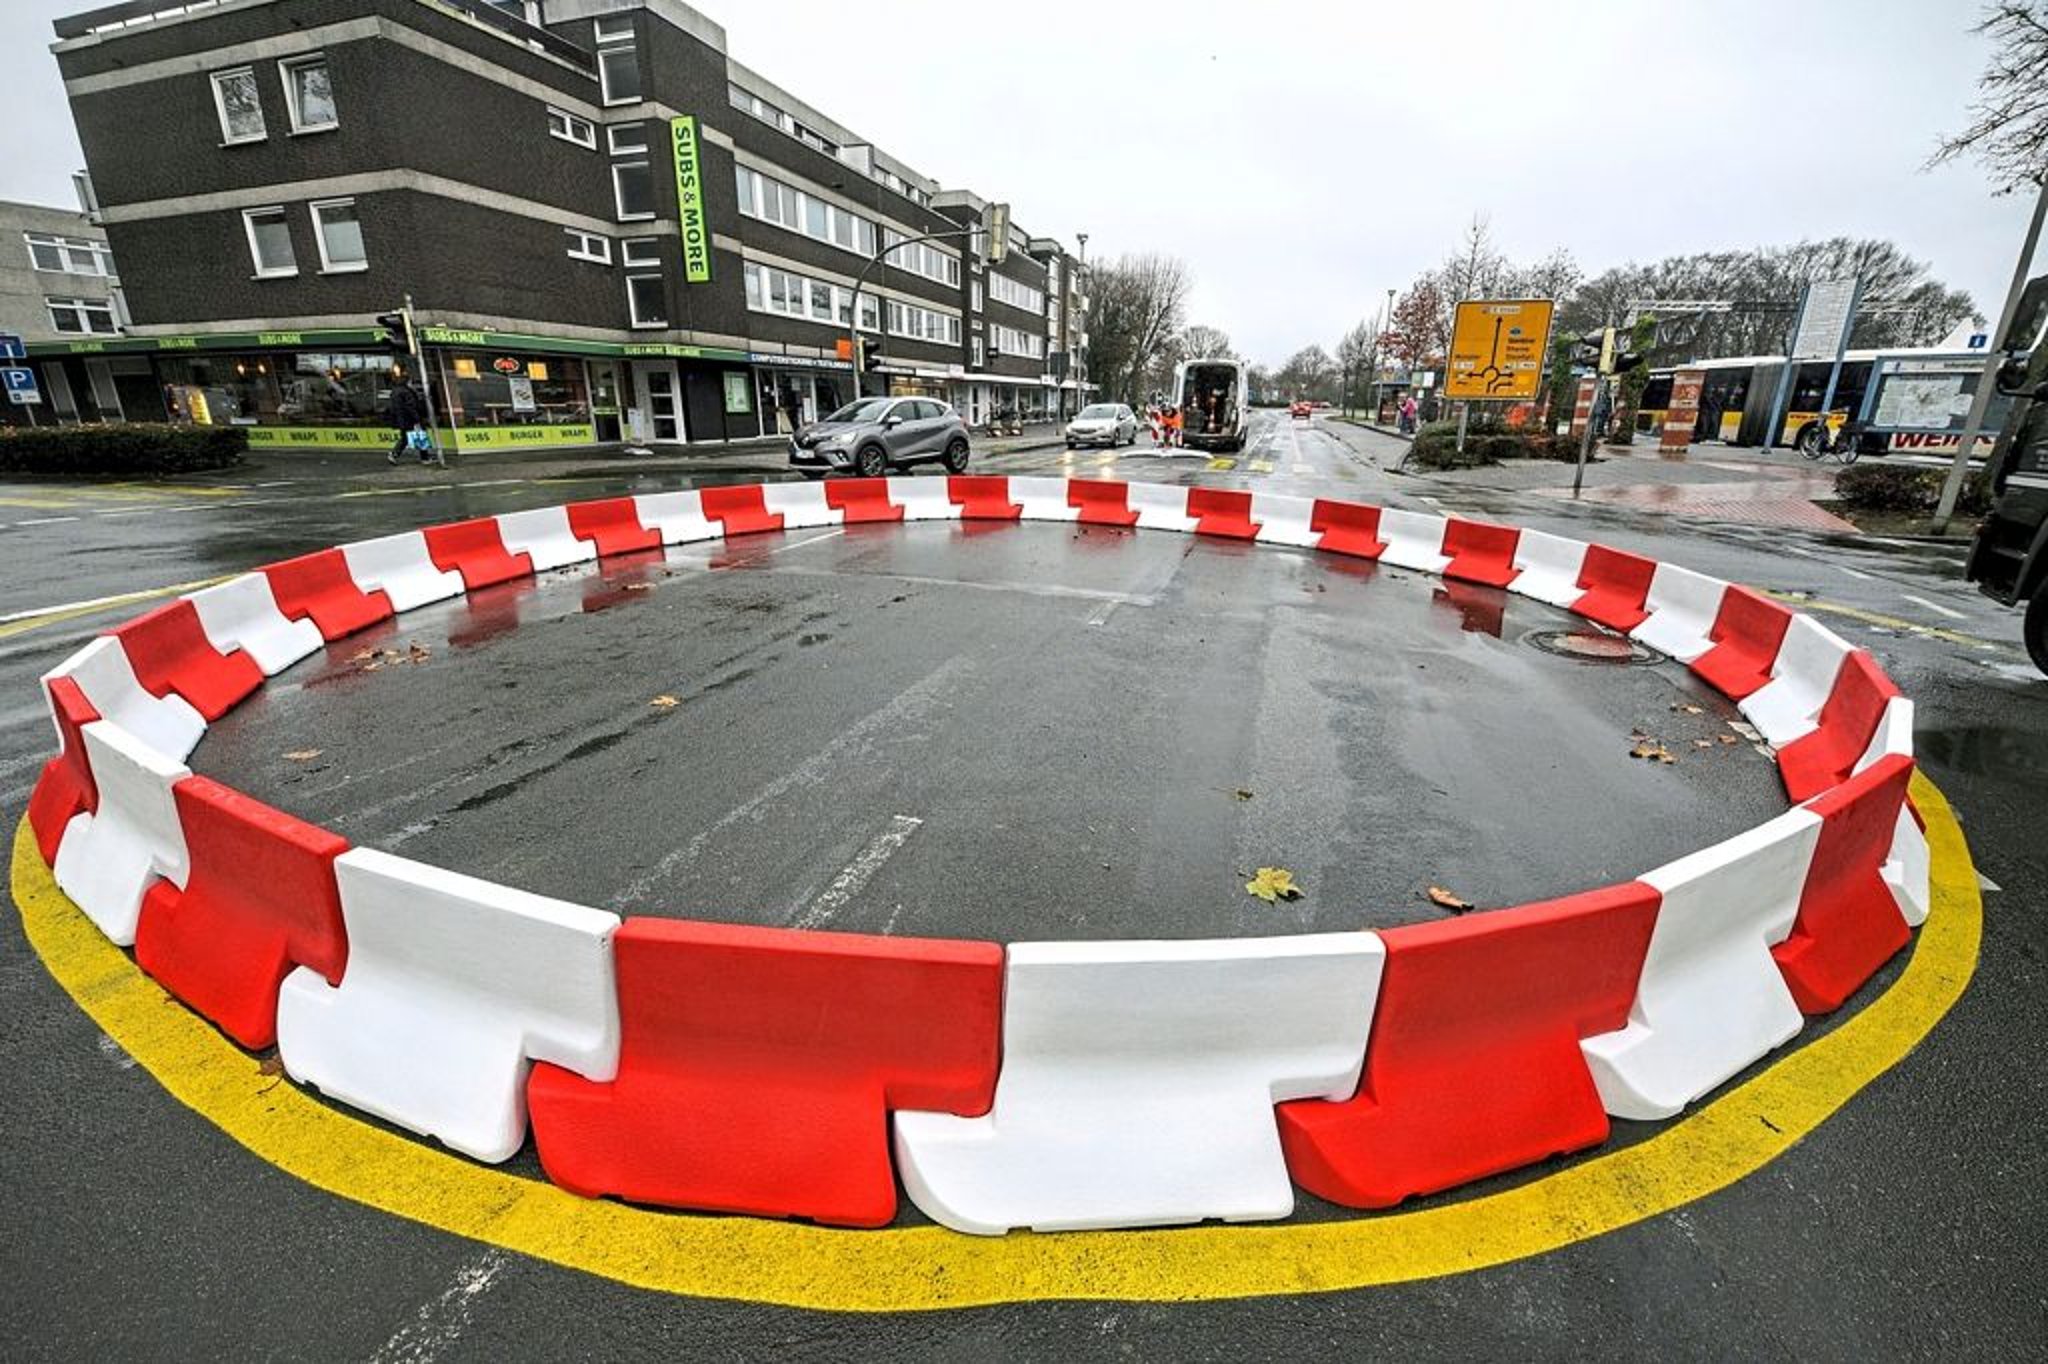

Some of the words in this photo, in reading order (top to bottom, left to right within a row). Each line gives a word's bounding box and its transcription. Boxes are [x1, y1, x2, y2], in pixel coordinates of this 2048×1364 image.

[675, 126, 695, 189] SUBS
[683, 191, 697, 203] &
[683, 208, 705, 273] MORE
[426, 329, 452, 342] SUBS
[460, 332, 485, 345] MORE
[9, 371, 26, 388] P
[465, 431, 490, 443] SUBS
[509, 429, 544, 441] BURGER
[560, 427, 588, 438] WRAPS
